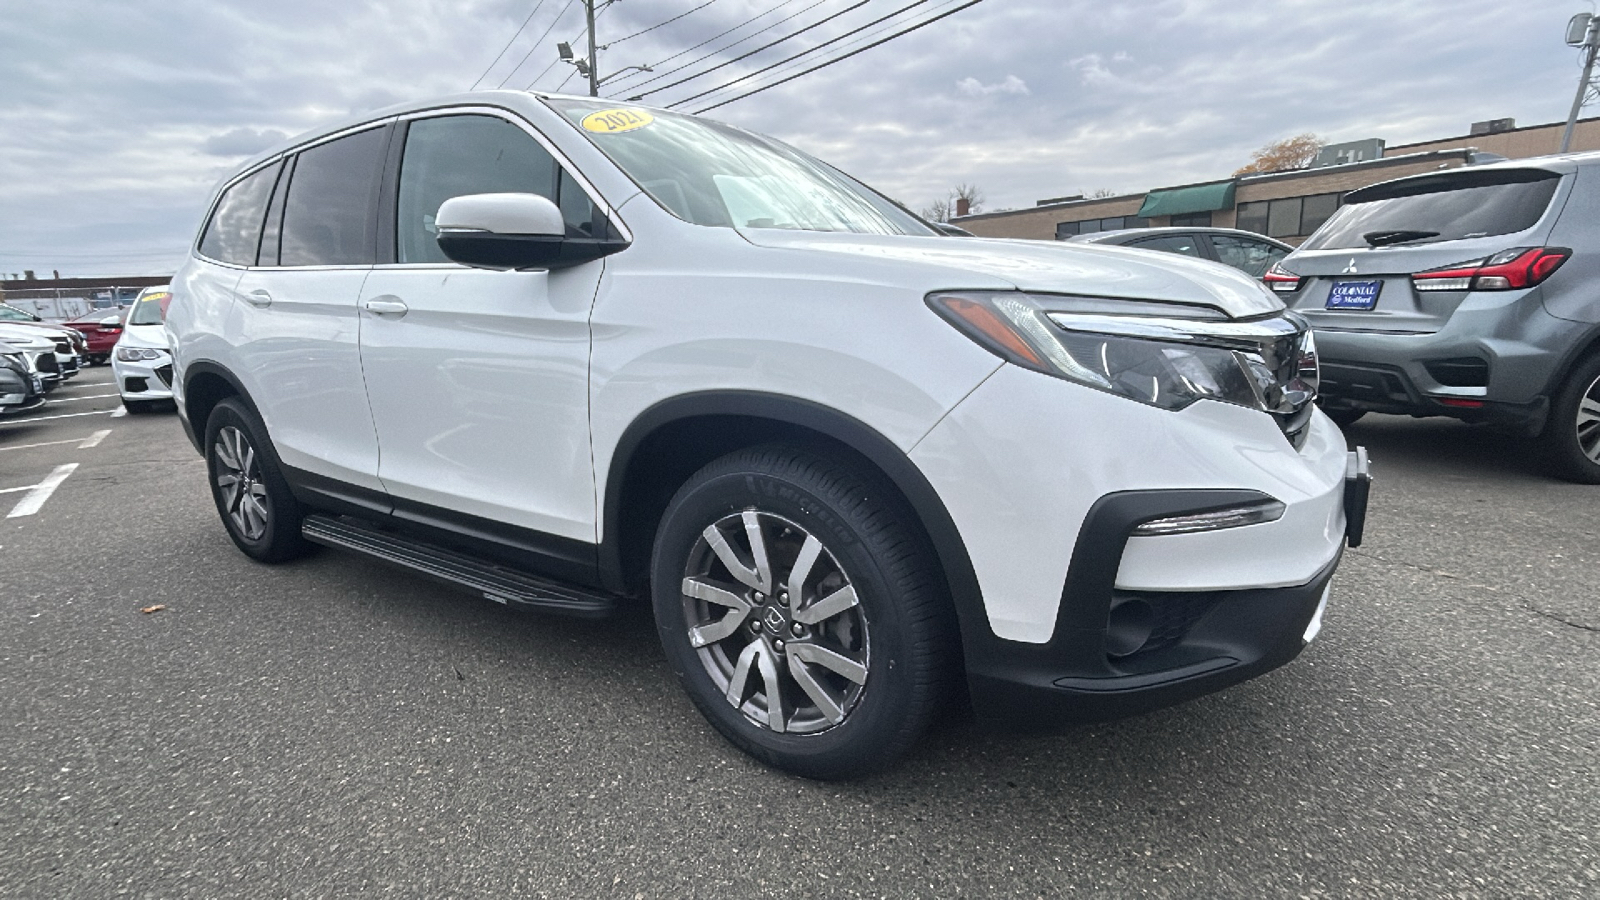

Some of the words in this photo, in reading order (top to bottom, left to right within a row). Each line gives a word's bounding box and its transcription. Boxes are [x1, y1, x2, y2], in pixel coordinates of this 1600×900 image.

[595, 110, 644, 130] 2021
[1333, 286, 1376, 295] COLONIAL
[1344, 296, 1372, 304] Medford
[779, 486, 853, 543] MICHELIN
